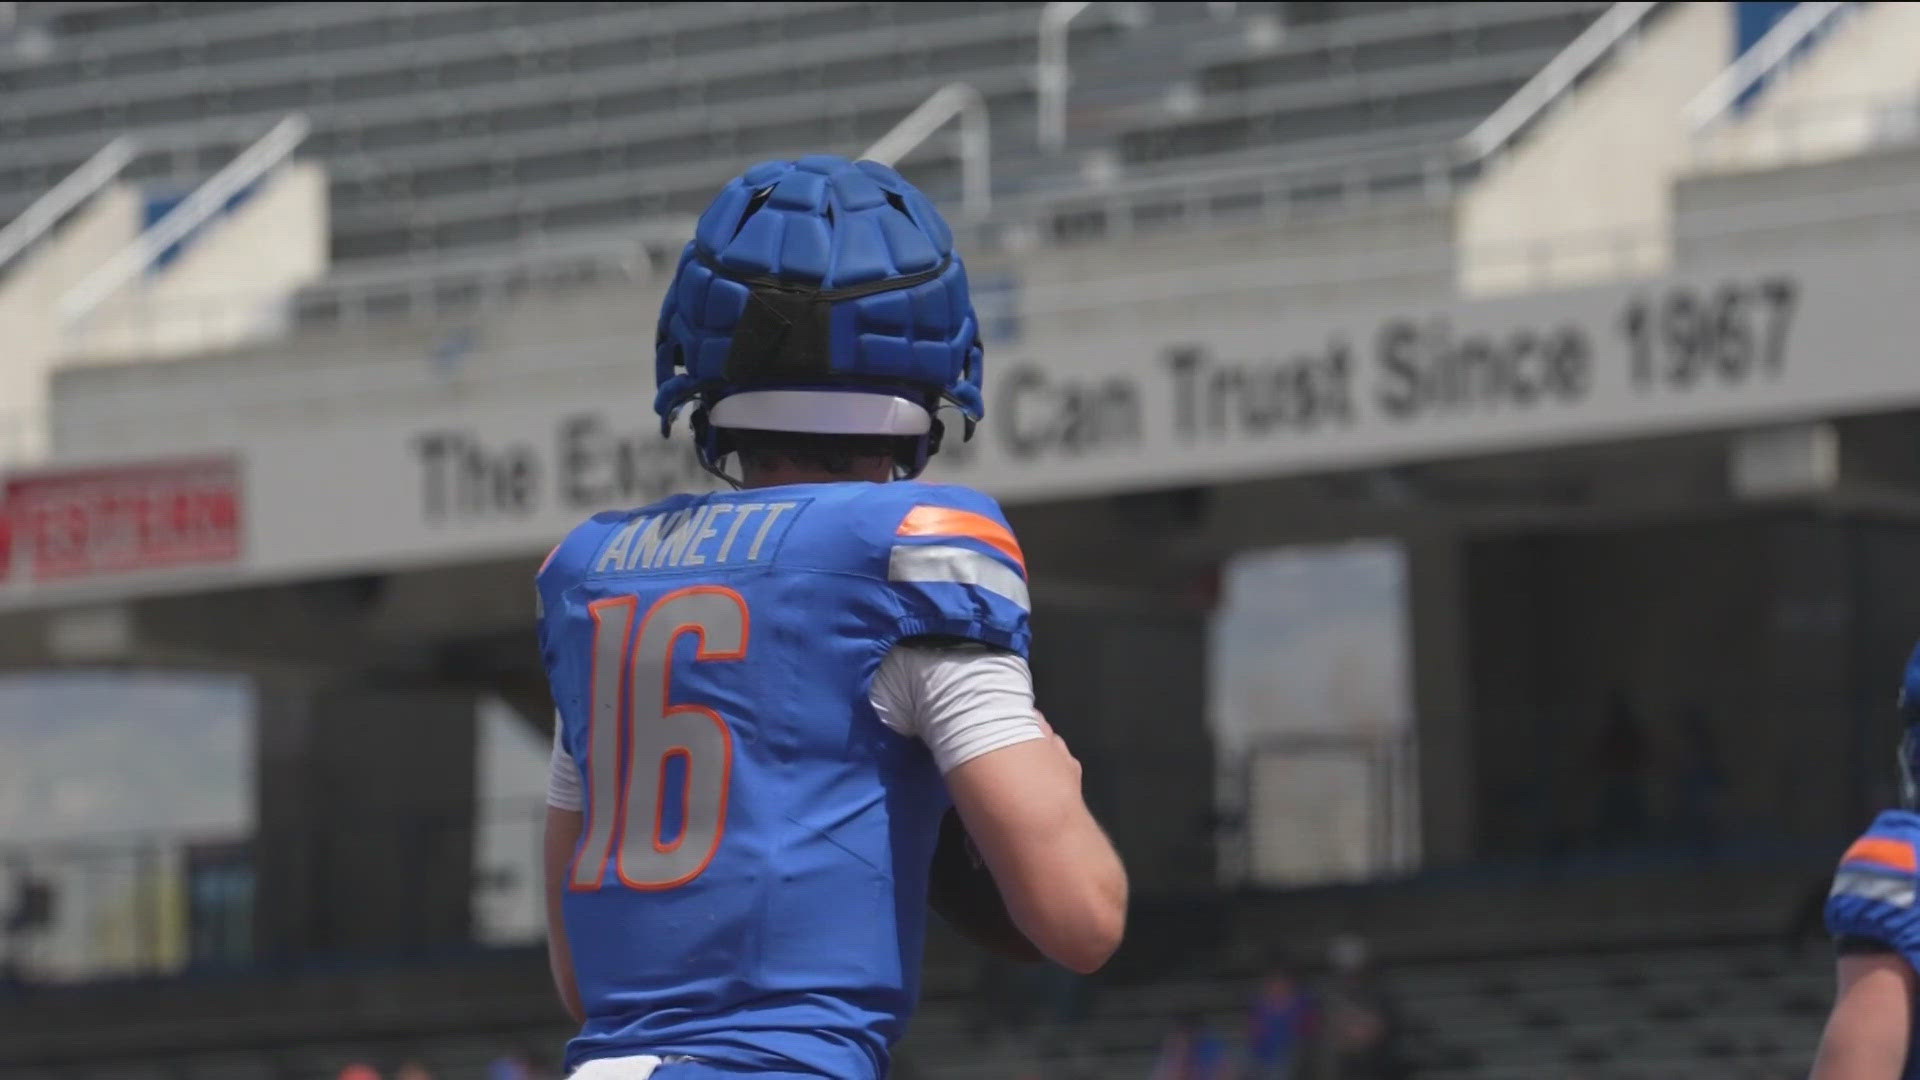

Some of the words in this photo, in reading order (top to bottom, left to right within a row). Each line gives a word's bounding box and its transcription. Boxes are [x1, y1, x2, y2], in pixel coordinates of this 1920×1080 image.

[410, 428, 541, 528] The
[999, 357, 1142, 458] Can
[1162, 334, 1356, 443] Trust
[1375, 314, 1594, 421] Since
[1618, 276, 1799, 394] 1967
[0, 478, 240, 578] ESTERN
[595, 501, 796, 572] ANNETT
[569, 584, 750, 892] 16
